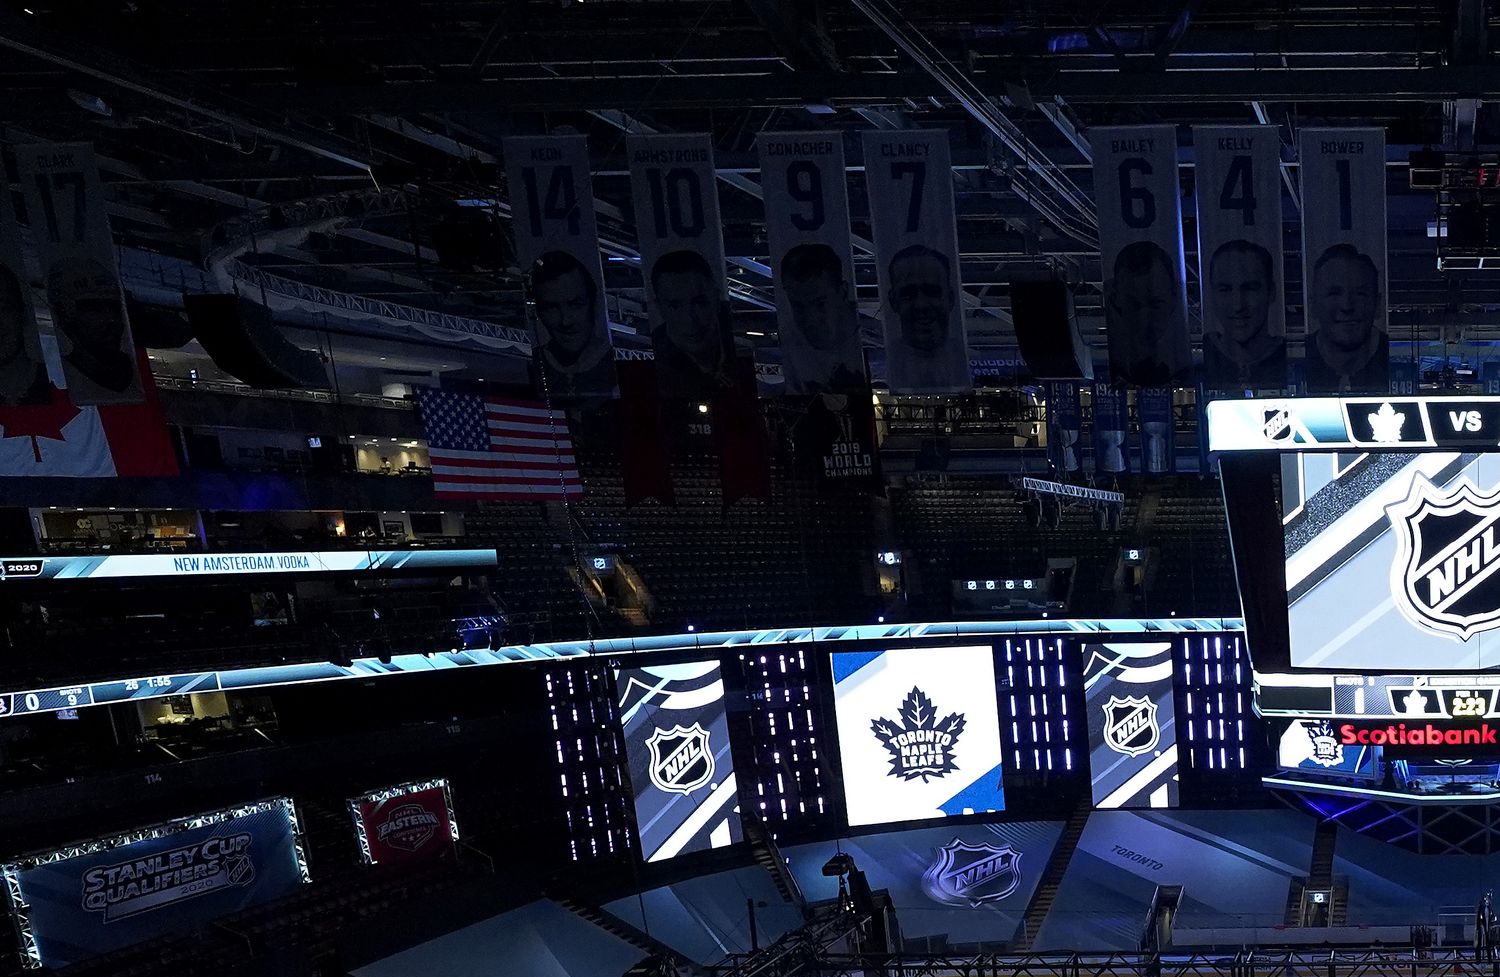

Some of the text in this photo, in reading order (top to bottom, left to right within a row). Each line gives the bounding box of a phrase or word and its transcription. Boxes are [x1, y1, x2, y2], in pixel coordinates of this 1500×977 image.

[767, 141, 833, 156] CONACHER
[881, 141, 931, 157] CLANCY
[1111, 139, 1155, 154] BAILEY
[1218, 137, 1254, 151] KELLY
[1320, 141, 1365, 155] BOWER
[529, 148, 563, 162] KEON
[786, 160, 826, 232] 9
[890, 161, 926, 233] 7
[1118, 157, 1157, 229] 6
[1220, 155, 1257, 226] 4
[1335, 159, 1352, 231] 1
[34, 172, 86, 242] 17
[520, 165, 581, 238] 14
[645, 167, 707, 239] 10
[1448, 410, 1483, 433] VS
[831, 442, 861, 455] 2019
[823, 454, 872, 469] WORLD
[824, 467, 873, 479] CHAMPIONS
[7, 562, 39, 574] 2020
[174, 555, 310, 573] NEW AMSTERDAM VODKA
[124, 680, 140, 692] 26
[24, 693, 78, 712] 0 9
[1353, 687, 1365, 715] 1
[1452, 697, 1486, 717] 2:23
[1117, 712, 1149, 743] NHL
[1340, 723, 1498, 746] Scotiabank
[889, 730, 952, 750] TORONTO
[901, 743, 943, 757] MAPLE
[664, 740, 702, 779] NHL
[901, 754, 944, 768] LEAFS
[380, 813, 439, 834] EASTERN
[86, 834, 252, 893] STANLEY CUP
[1111, 843, 1165, 872] TORONTO
[86, 859, 221, 909] QUALIFIERS
[953, 858, 1020, 896] NHL
[180, 880, 215, 895] 2020
